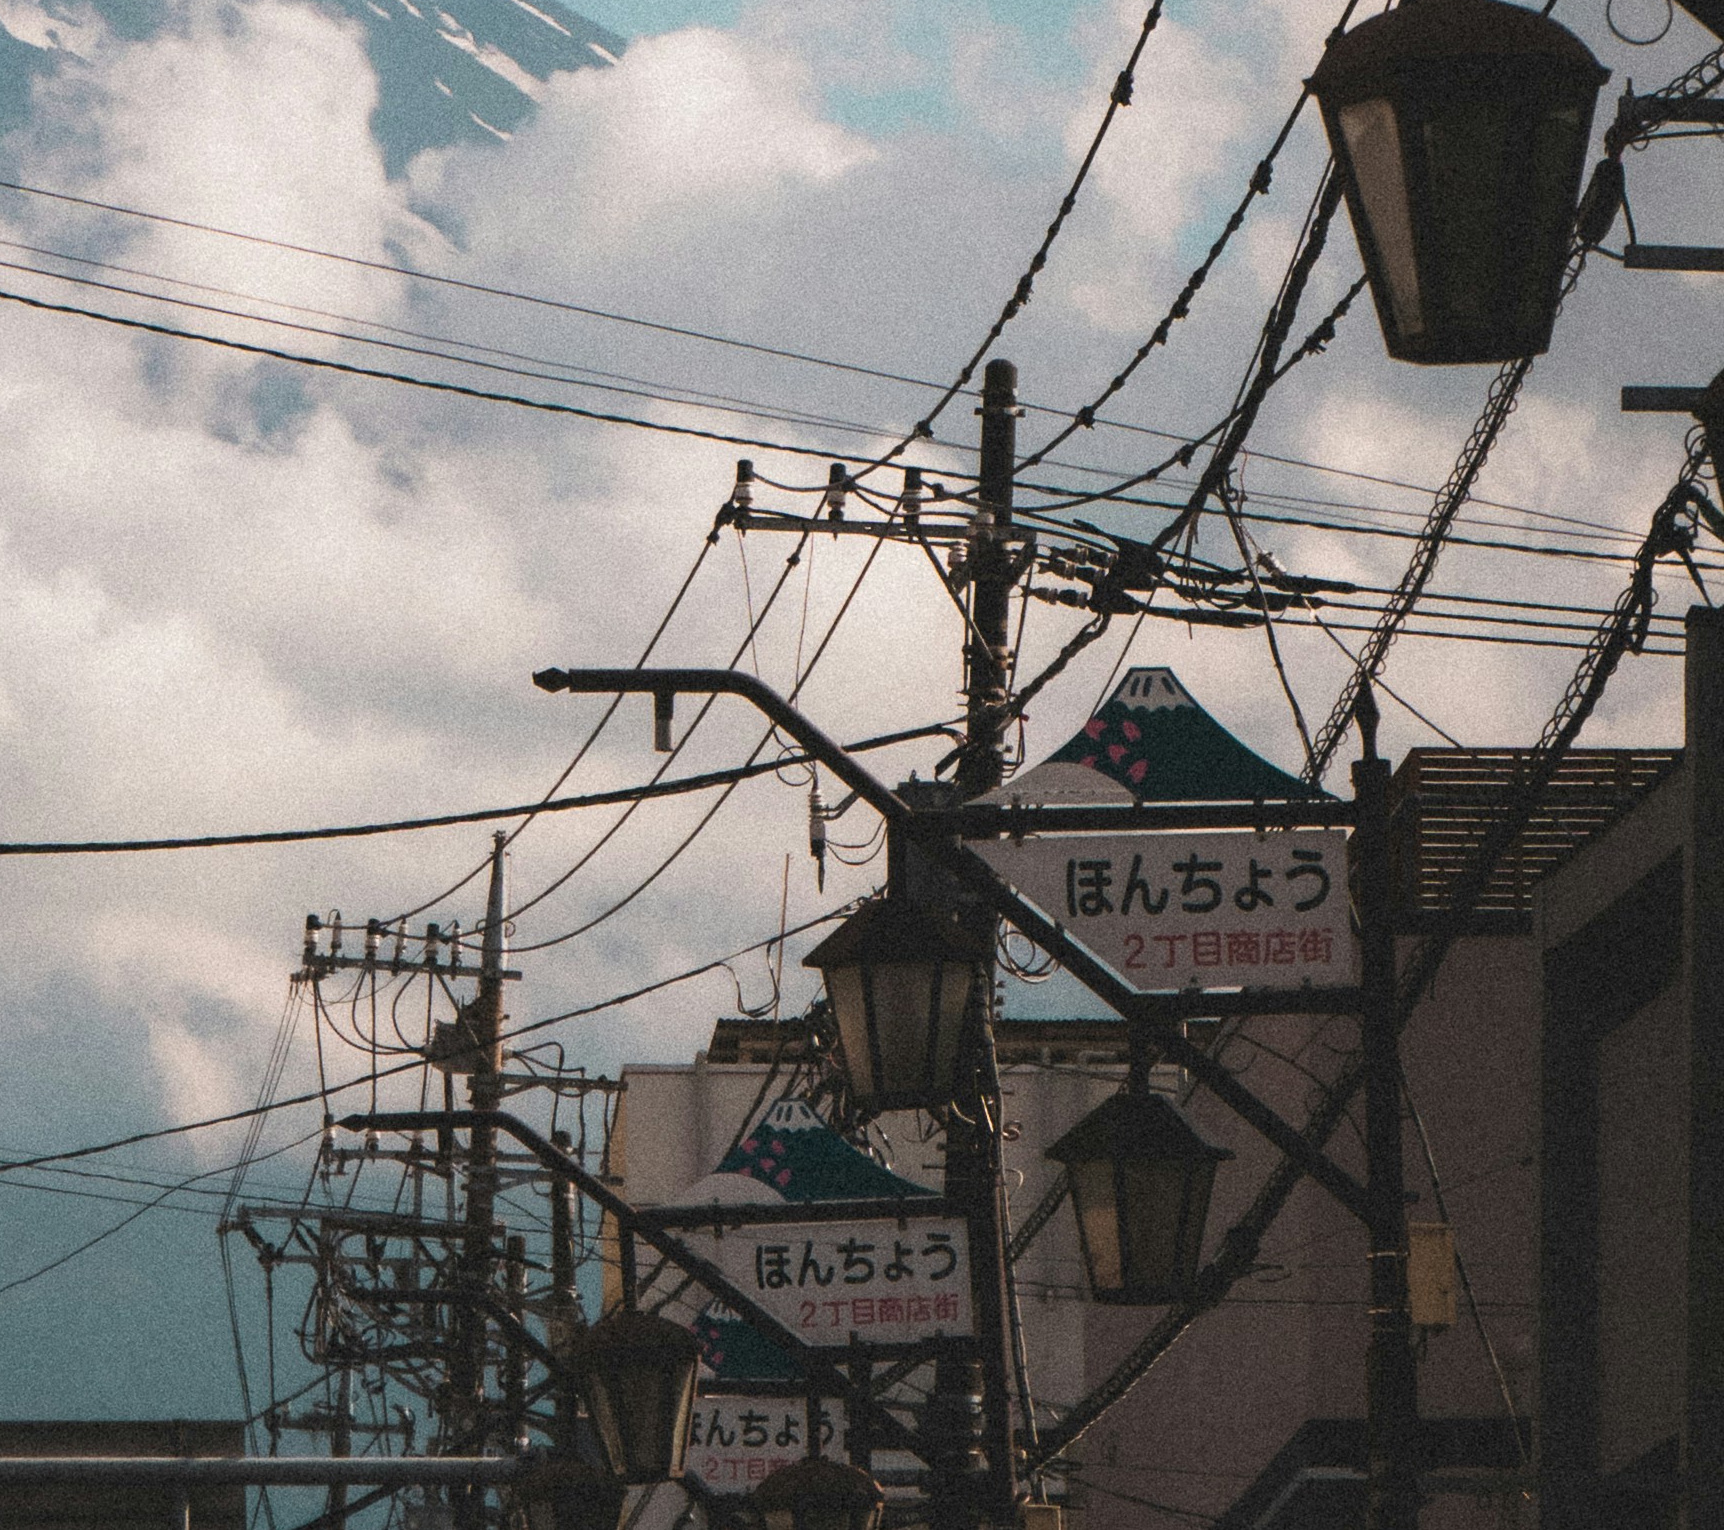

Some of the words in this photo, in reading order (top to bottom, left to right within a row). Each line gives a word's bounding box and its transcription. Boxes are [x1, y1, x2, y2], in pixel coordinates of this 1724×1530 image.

[1065, 848, 1331, 919] ほんちょう
[1123, 927, 1333, 972] 2丁目商店街
[756, 1232, 958, 1290] ほんちょう
[801, 1294, 959, 1330] 2丁目商店街
